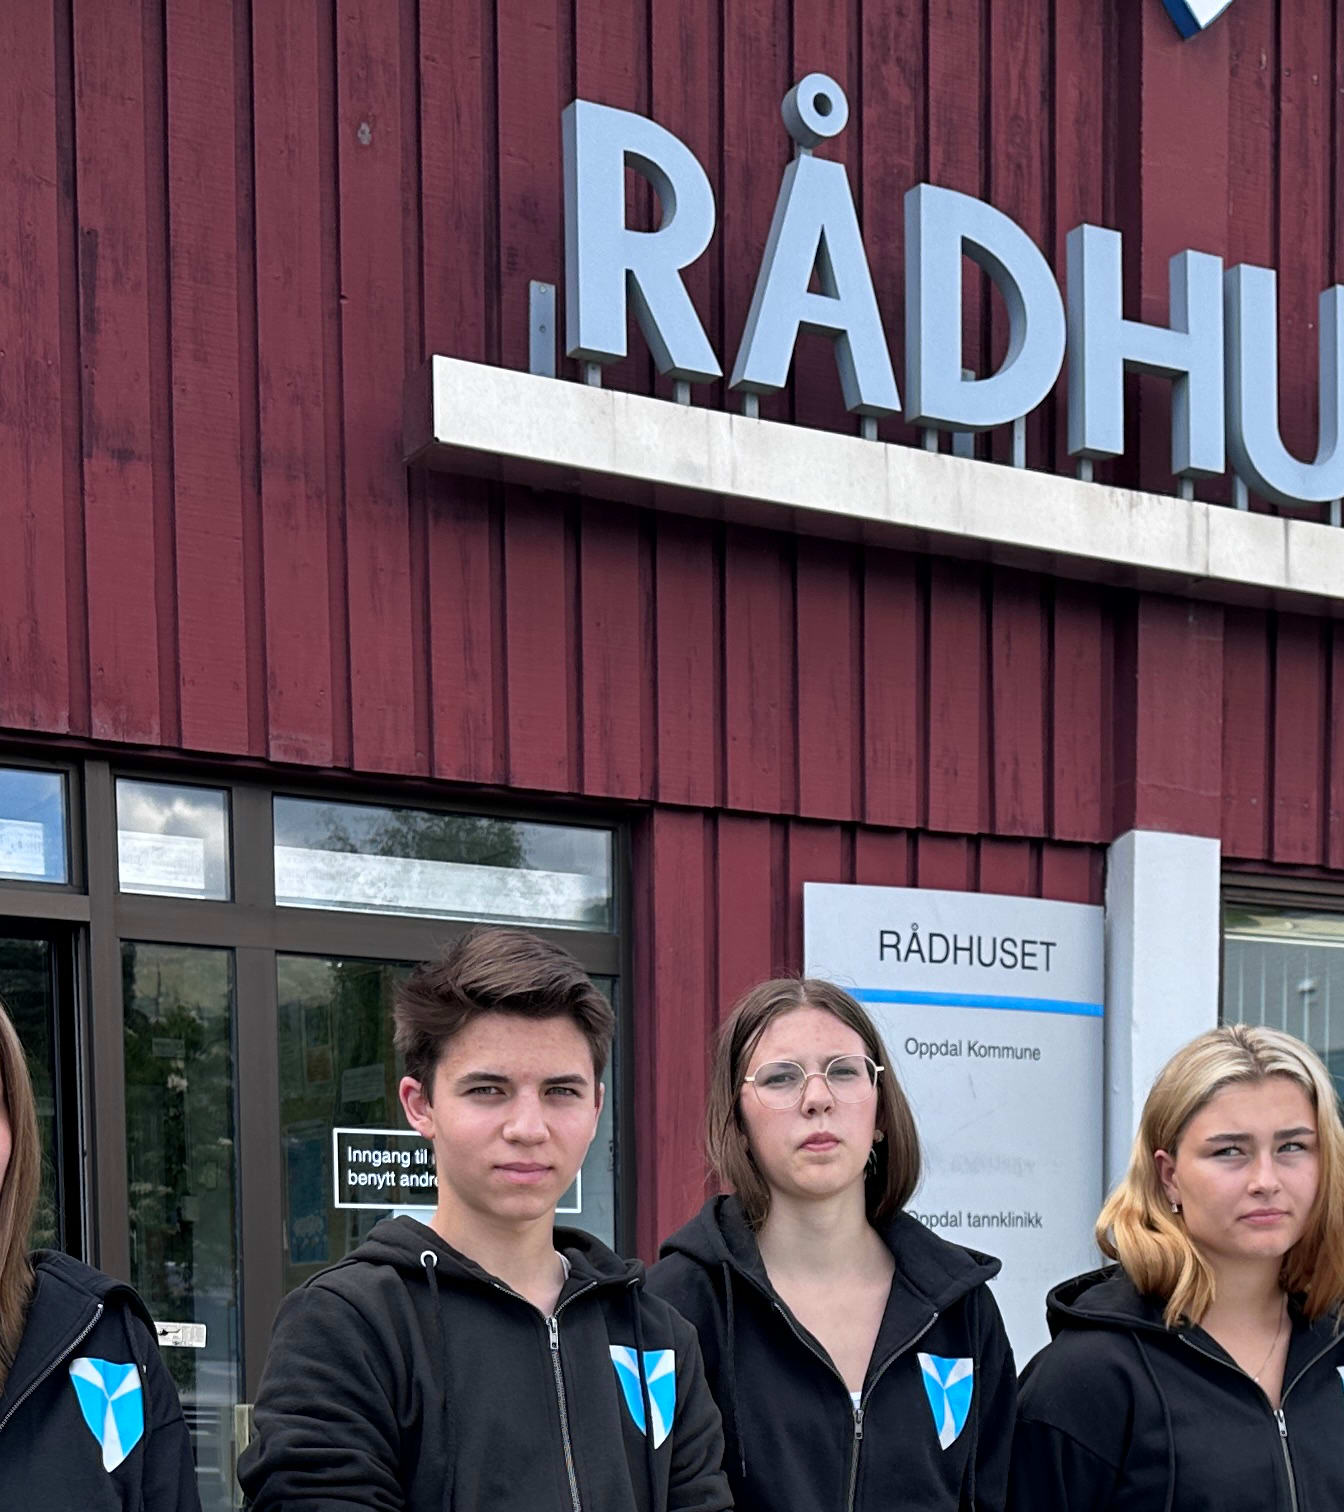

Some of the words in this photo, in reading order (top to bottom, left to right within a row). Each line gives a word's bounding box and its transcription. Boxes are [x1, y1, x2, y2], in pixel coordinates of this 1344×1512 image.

[878, 923, 1057, 973] RÅDHUSET
[904, 1036, 962, 1061] Oppdal
[967, 1039, 1042, 1062] Kommune
[347, 1146, 411, 1168] Inngang
[415, 1148, 428, 1164] til
[347, 1169, 396, 1190] benytt
[966, 1210, 1044, 1230] tannklinikk
